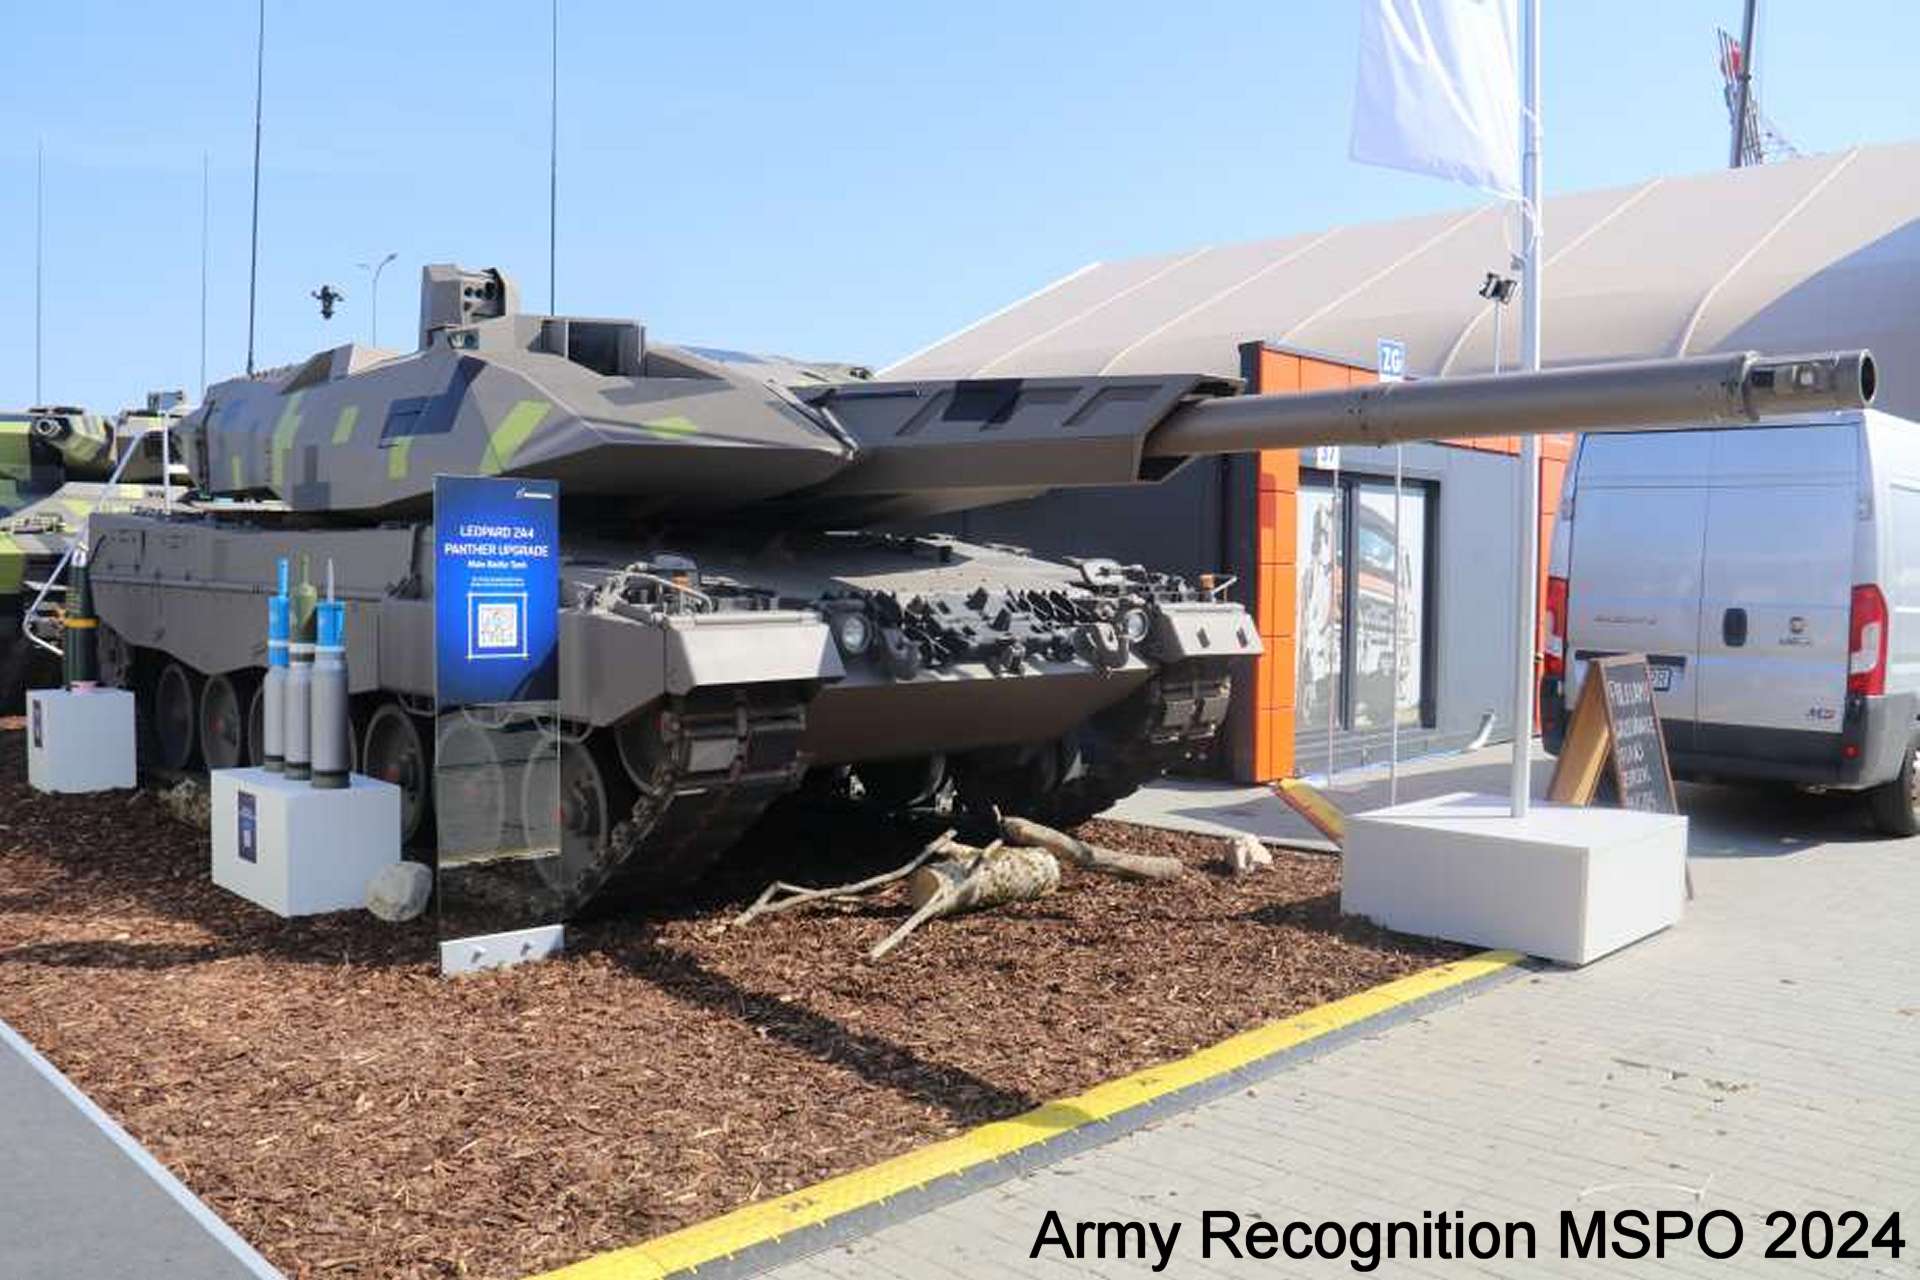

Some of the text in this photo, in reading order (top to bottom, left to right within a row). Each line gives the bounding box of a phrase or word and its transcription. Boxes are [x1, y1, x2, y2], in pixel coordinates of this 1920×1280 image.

[459, 524, 511, 538] LEOPARD
[444, 543, 549, 558] PANTHER UPGRADE
